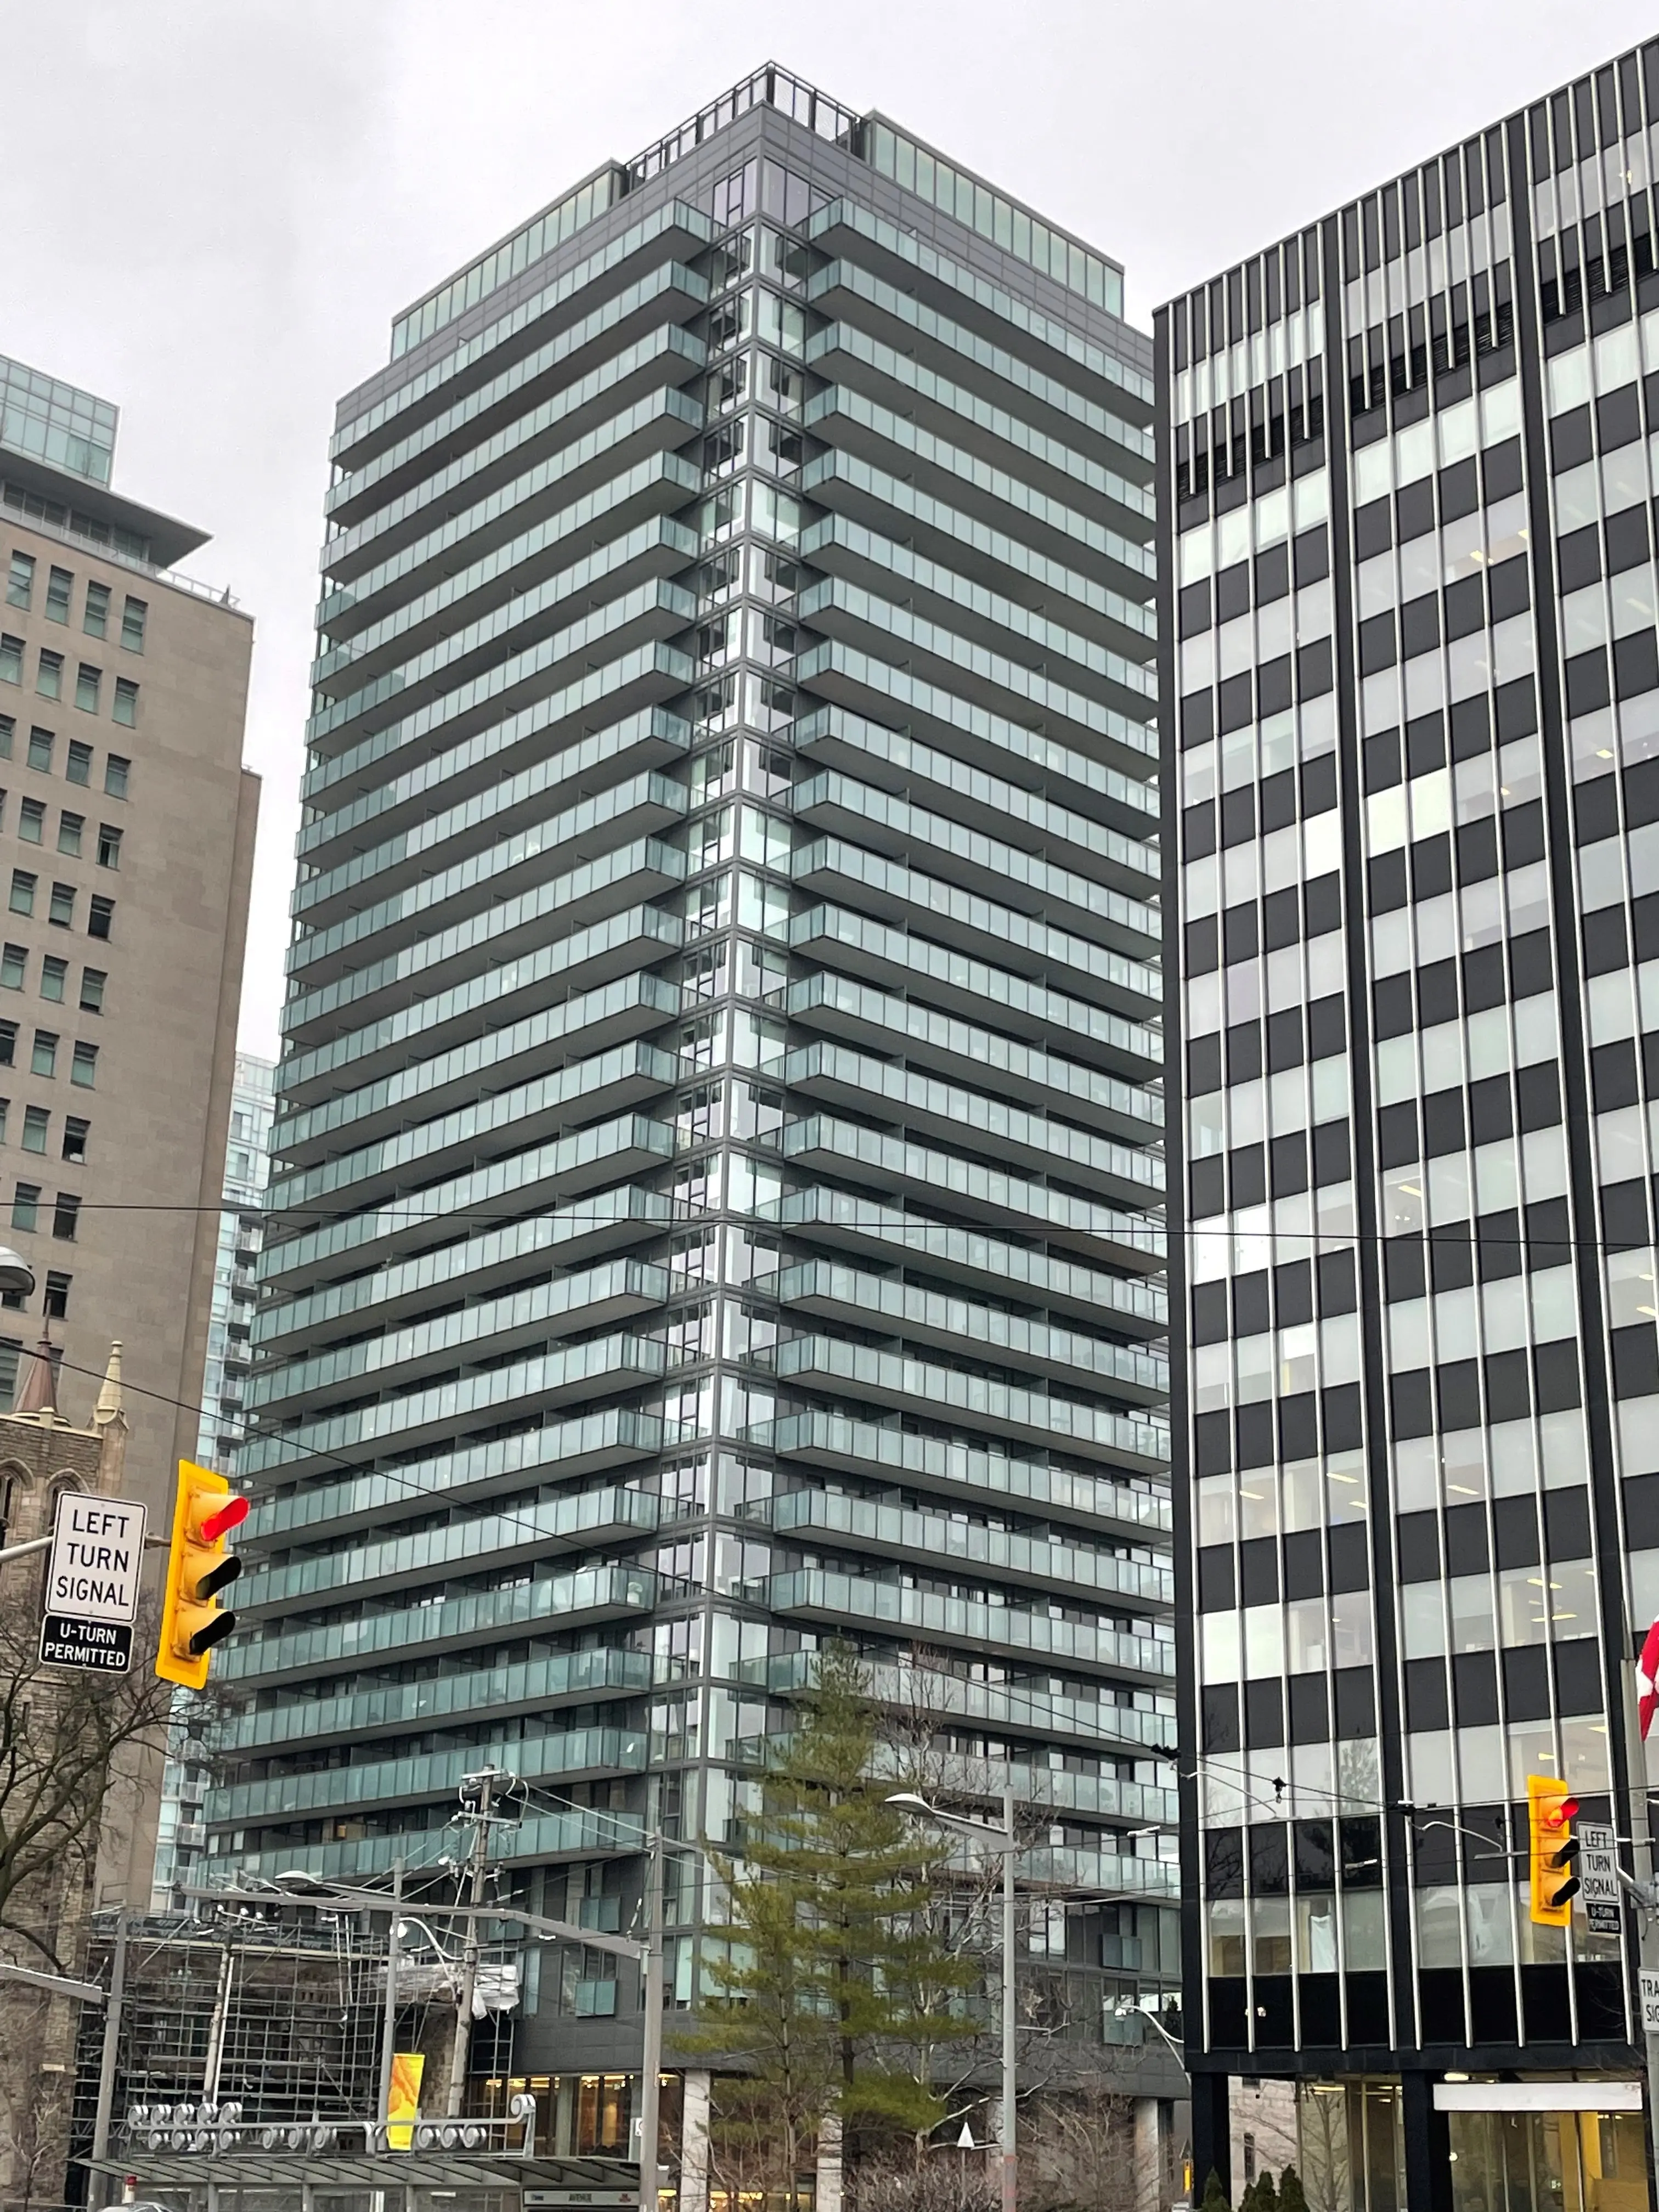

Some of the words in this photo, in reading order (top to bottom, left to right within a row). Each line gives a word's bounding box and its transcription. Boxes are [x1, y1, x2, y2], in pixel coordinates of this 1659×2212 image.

[72, 1509, 129, 1538] LEFT
[67, 1542, 129, 1572] TURN
[57, 1576, 129, 1606] SIGNAL
[60, 1622, 117, 1645] U-TURN
[44, 1642, 126, 1667] PERMITTED
[1585, 1830, 1606, 1848] LEFT
[1587, 1854, 1611, 1872] TURN
[1584, 1877, 1617, 1896] SIGNAL
